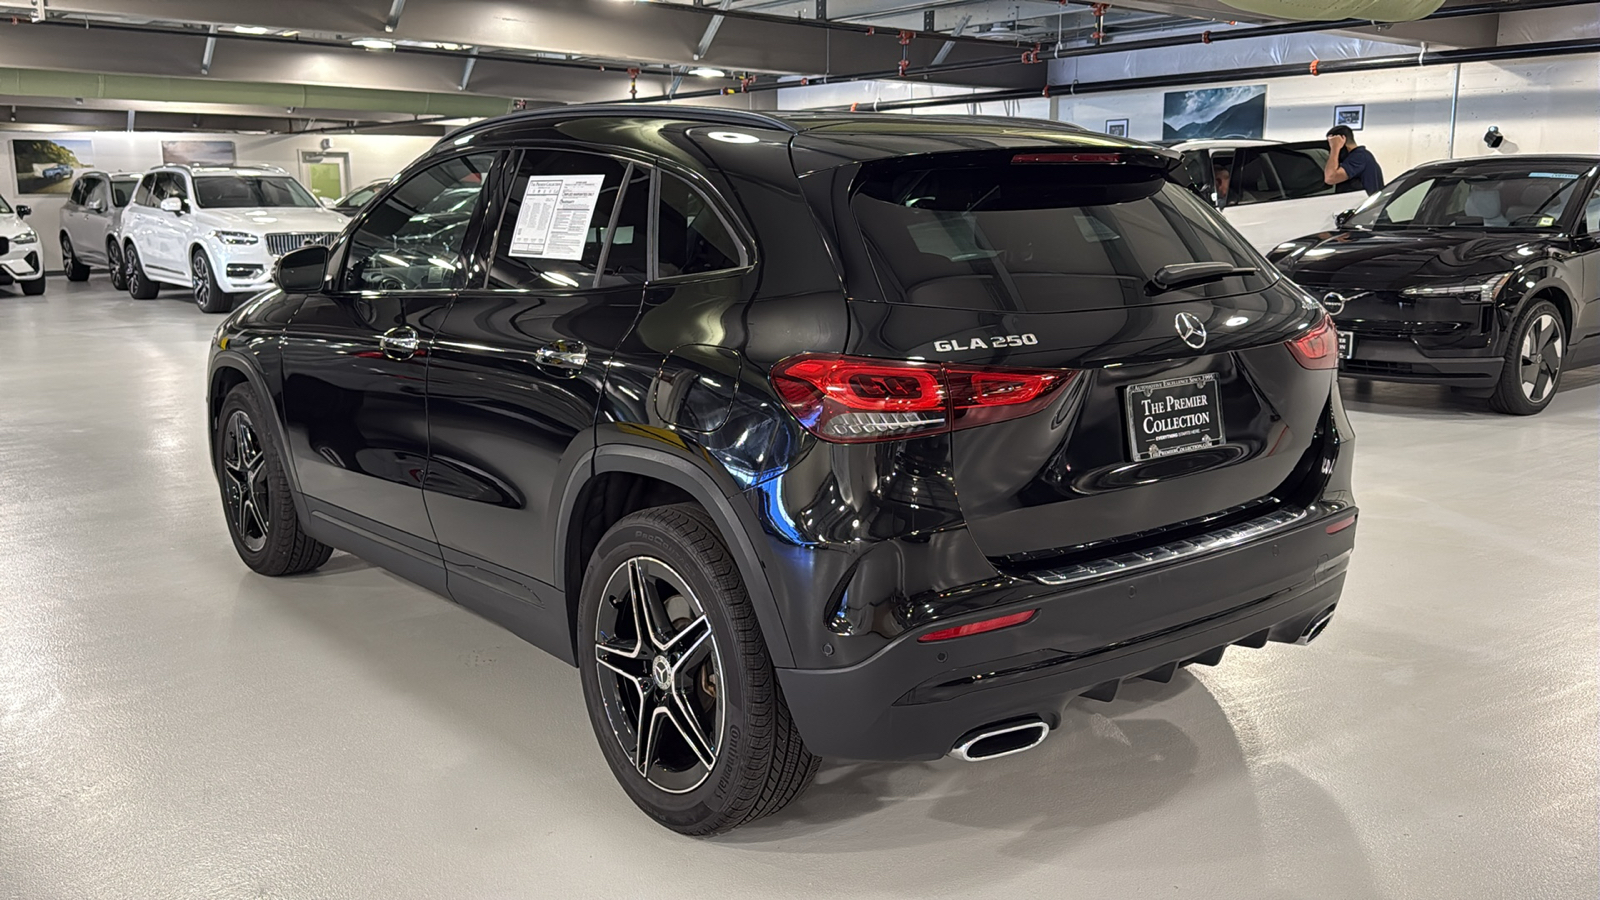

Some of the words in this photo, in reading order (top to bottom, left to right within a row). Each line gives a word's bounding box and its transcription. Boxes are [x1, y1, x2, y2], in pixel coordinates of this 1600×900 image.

[933, 337, 988, 352] GLA
[990, 333, 1038, 348] 250
[1141, 399, 1165, 416] THE
[1165, 395, 1208, 412] PREMIER
[1143, 411, 1210, 434] COLLECTION
